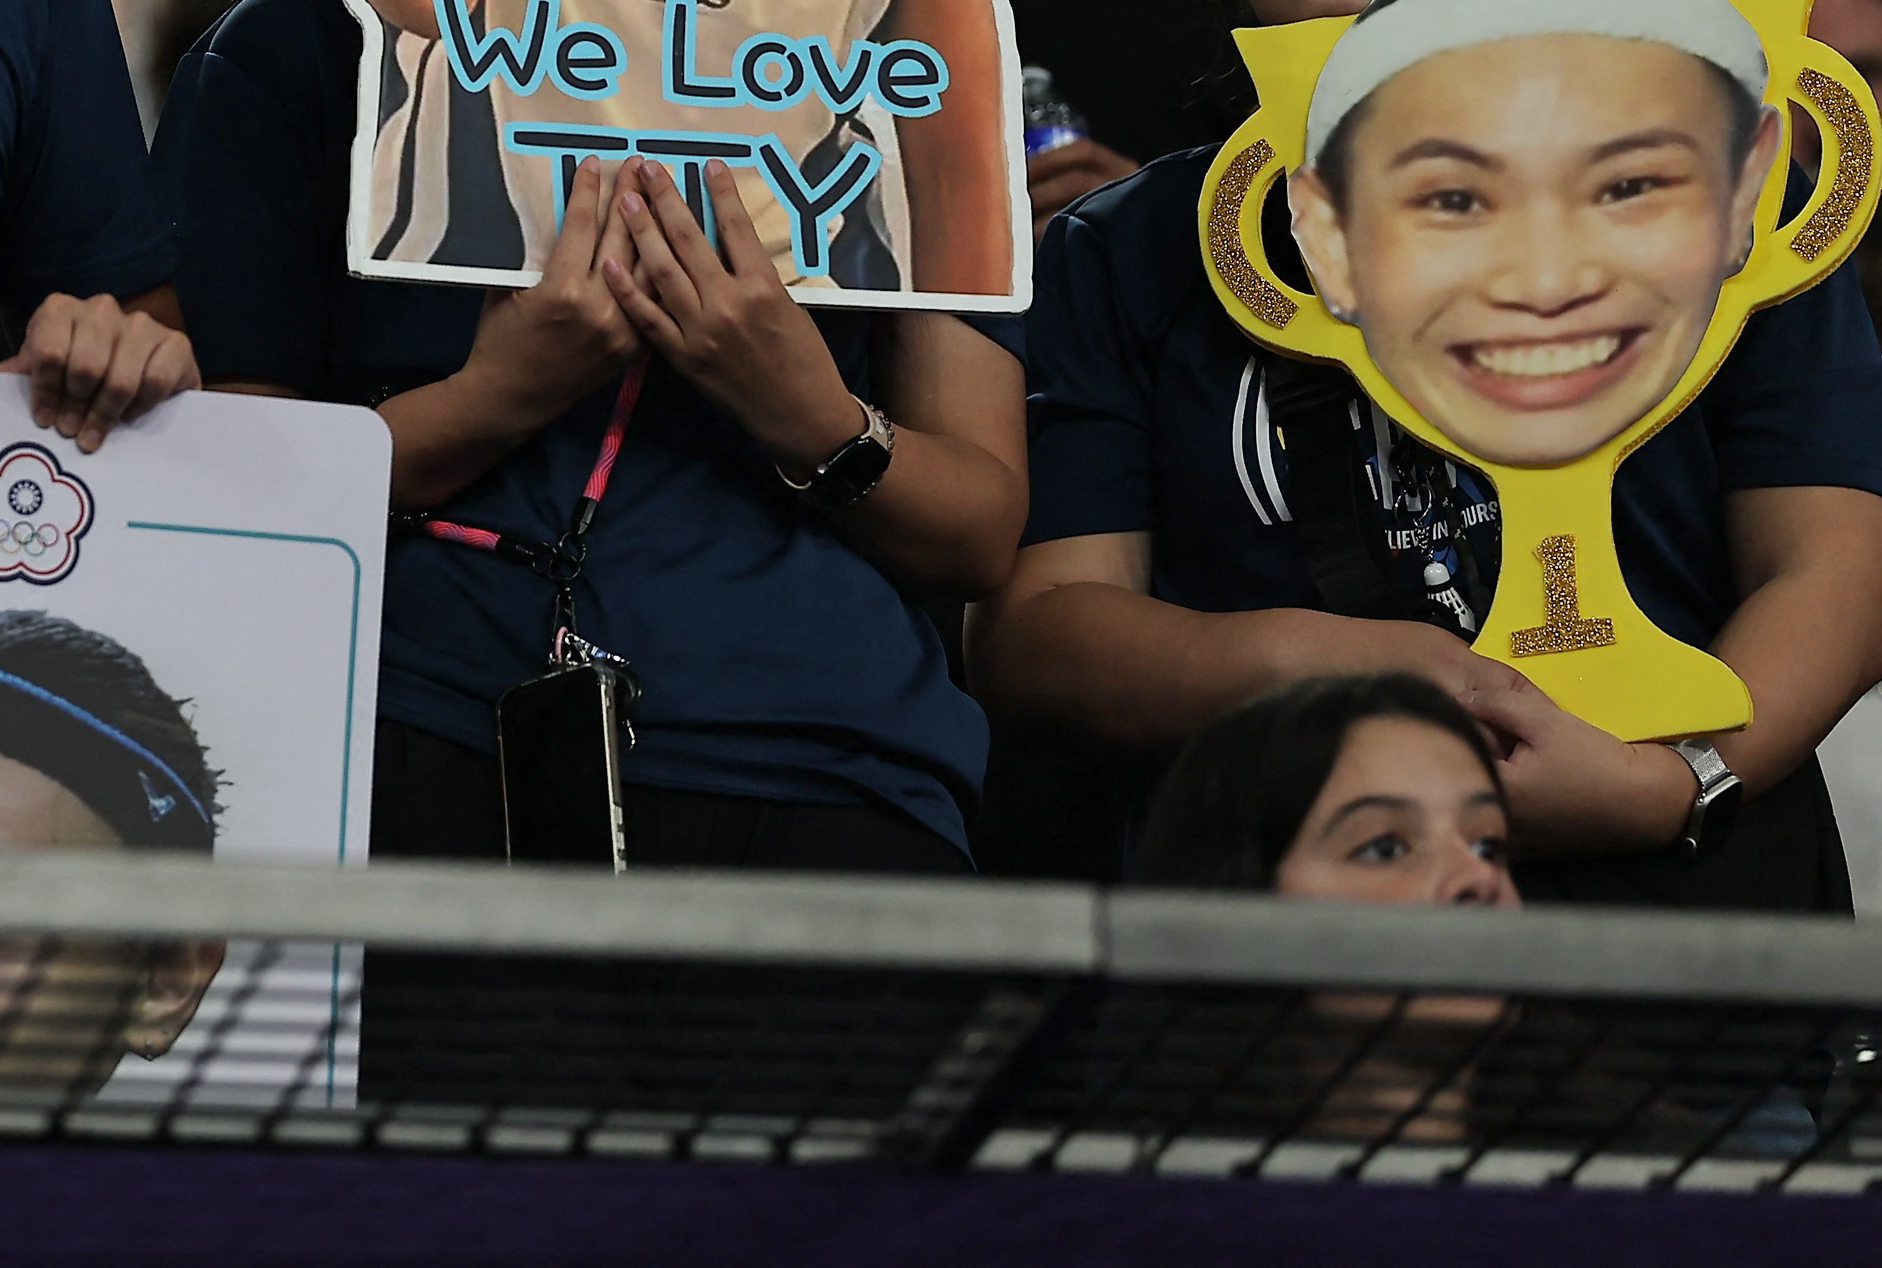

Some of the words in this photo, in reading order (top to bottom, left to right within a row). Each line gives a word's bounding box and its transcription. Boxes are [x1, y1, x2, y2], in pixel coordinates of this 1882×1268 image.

[505, 122, 882, 276] TTY
[1432, 520, 1449, 541] IN
[1511, 535, 1616, 657] 1
